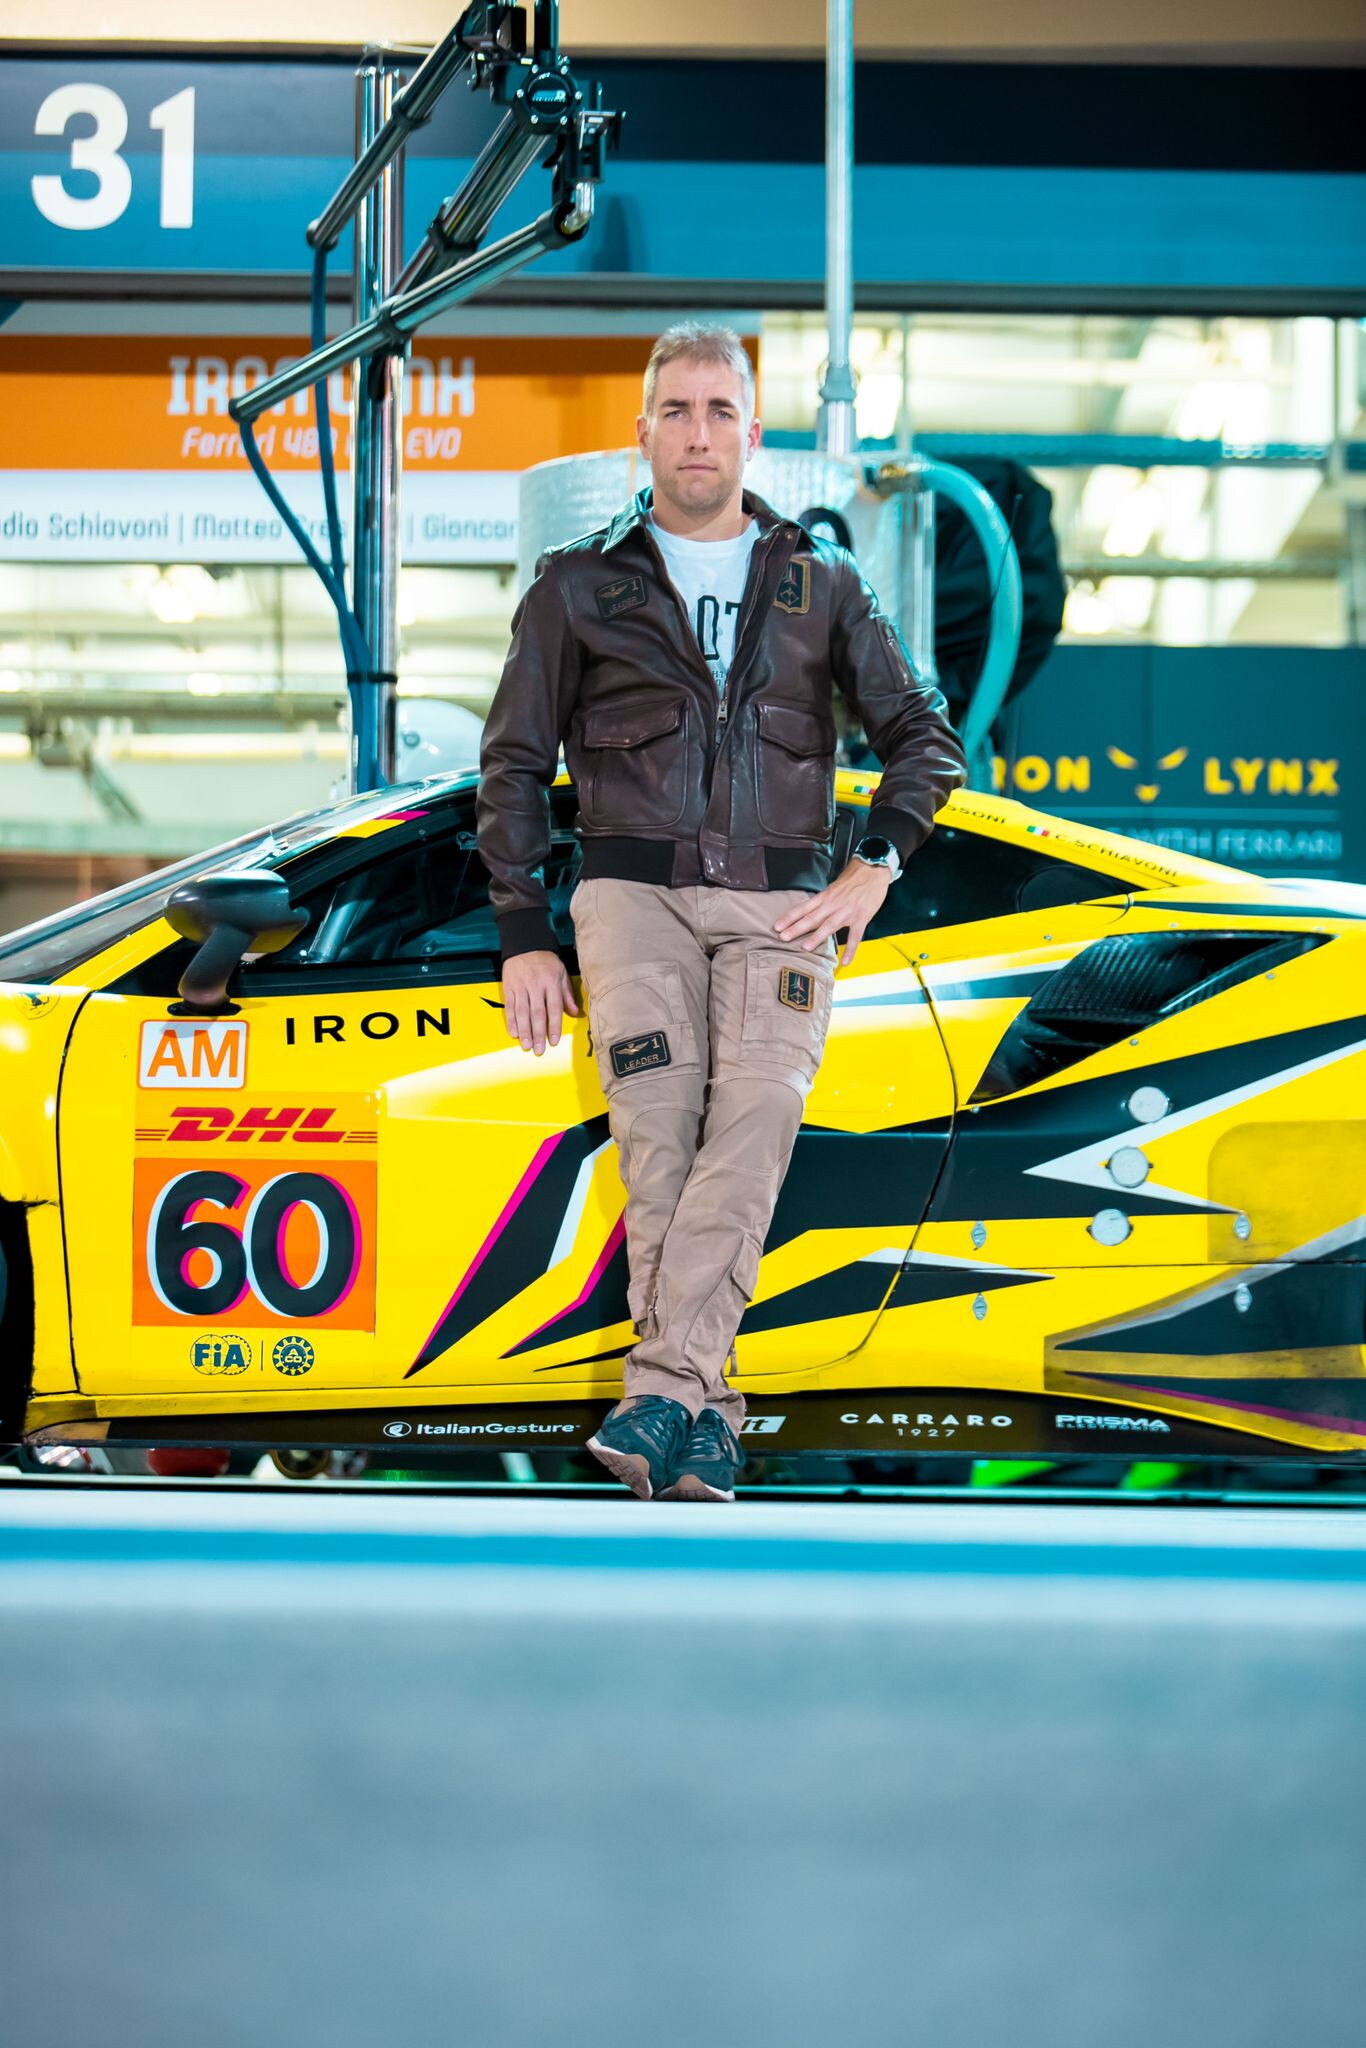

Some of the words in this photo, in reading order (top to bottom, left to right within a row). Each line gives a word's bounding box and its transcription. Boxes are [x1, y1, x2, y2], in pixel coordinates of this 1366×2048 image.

[31, 83, 196, 232] 31
[1203, 756, 1340, 796] LYNX
[285, 1007, 452, 1046] IRON
[146, 1028, 240, 1078] AM
[624, 1053, 660, 1071] LEADER
[166, 1106, 347, 1143] DHL
[147, 1169, 363, 1318] 60
[416, 1422, 576, 1435] ItalianGesture
[840, 1412, 1013, 1427] CARRARO
[896, 1427, 956, 1438] 1927
[1055, 1414, 1169, 1428] PRISMA
